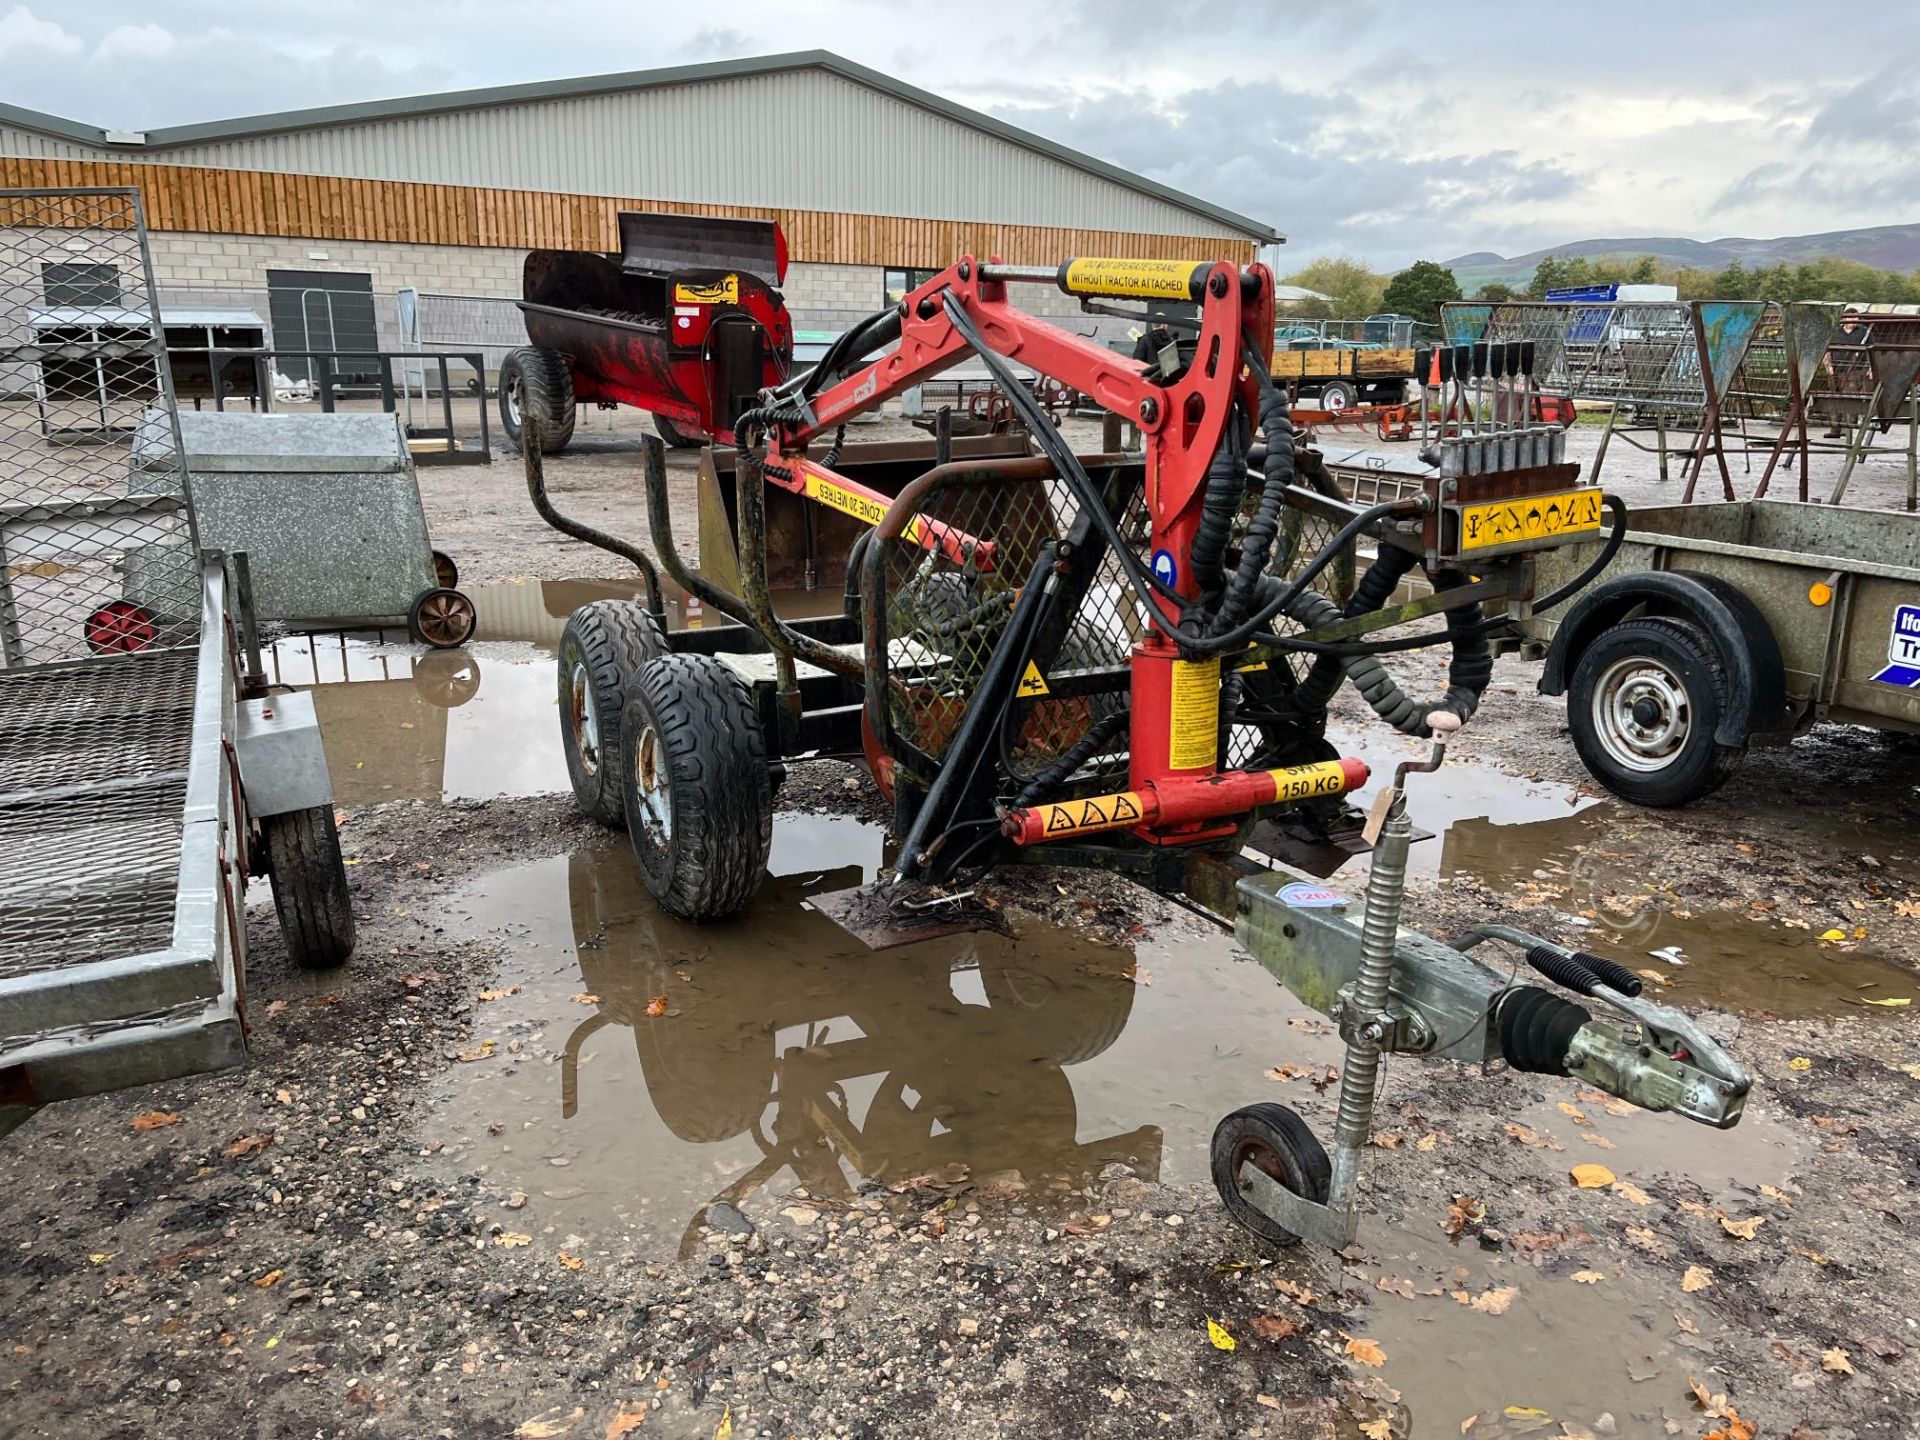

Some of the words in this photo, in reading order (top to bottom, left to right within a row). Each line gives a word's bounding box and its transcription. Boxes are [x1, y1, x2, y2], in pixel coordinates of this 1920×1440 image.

[1113, 261, 1148, 272] OPERATE
[1148, 262, 1180, 273] CRANE
[1072, 273, 1102, 286] WITHOUT
[1105, 276, 1139, 288] TRACTOR
[1141, 278, 1183, 291] ATTACHED
[820, 484, 848, 507] METRES
[849, 497, 857, 512] 20
[859, 501, 880, 522] ZONE
[1282, 780, 1310, 798] 150
[1314, 775, 1339, 793] KG
